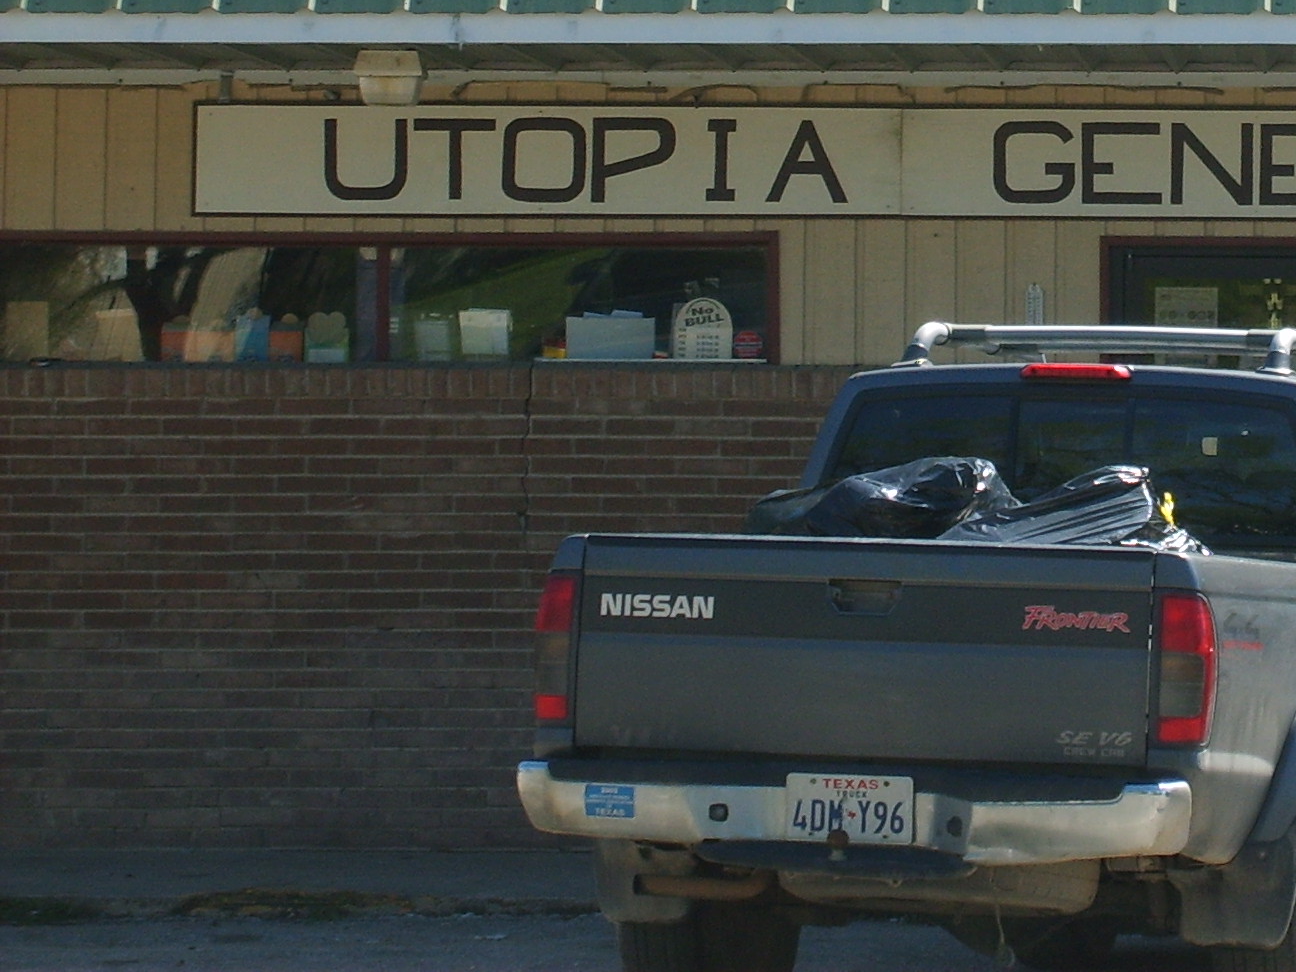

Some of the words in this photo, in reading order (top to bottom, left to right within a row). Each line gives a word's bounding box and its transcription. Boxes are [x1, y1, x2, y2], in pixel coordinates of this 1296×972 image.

[323, 116, 849, 204] UTOPIA
[685, 314, 725, 327] BULL
[600, 593, 715, 619] NISSAN
[1056, 730, 1093, 745] SE
[1098, 731, 1134, 746] V6
[822, 778, 879, 790] TEXAS
[836, 790, 869, 799] TRUCK
